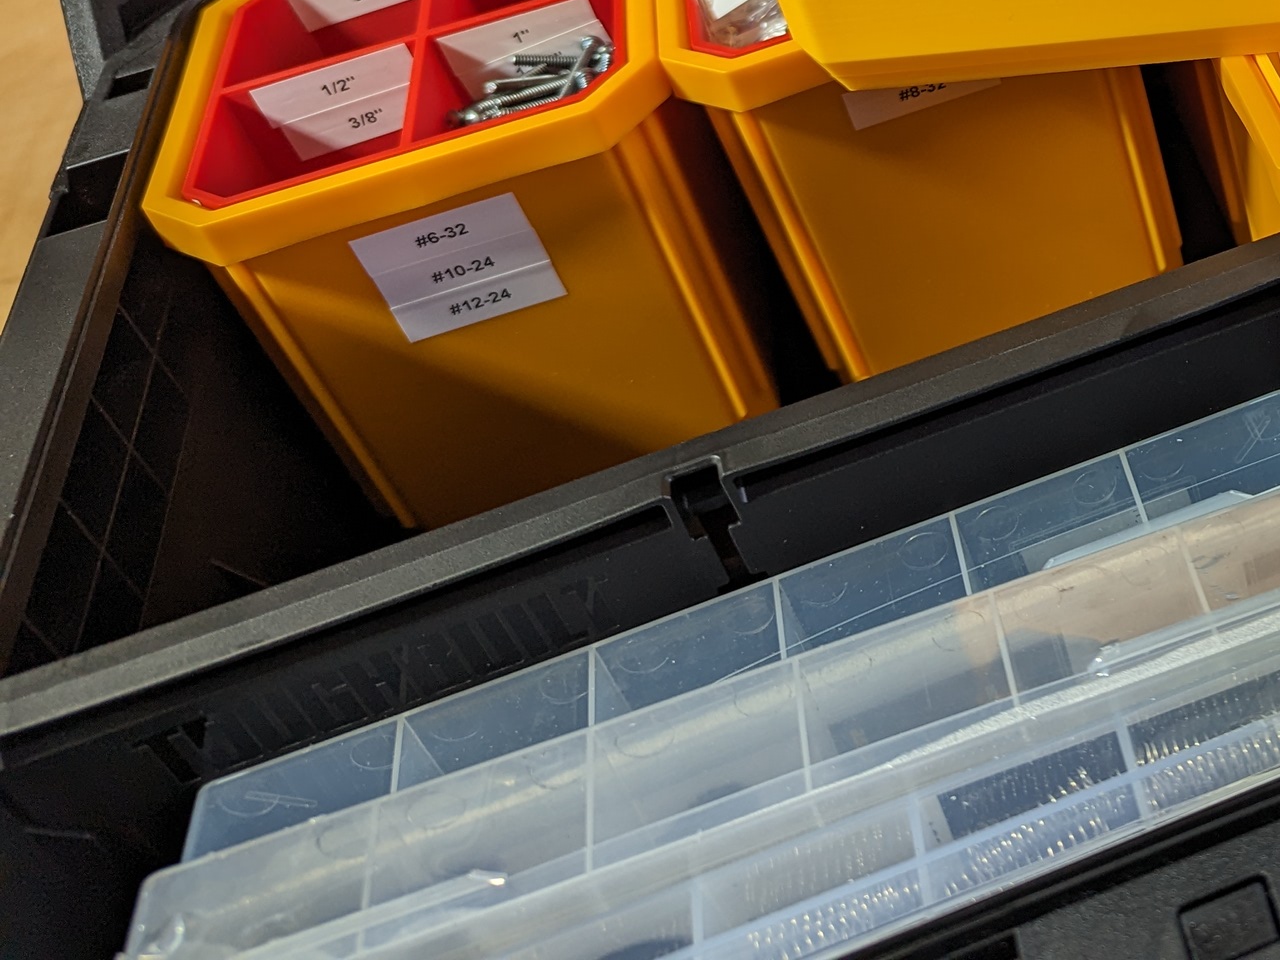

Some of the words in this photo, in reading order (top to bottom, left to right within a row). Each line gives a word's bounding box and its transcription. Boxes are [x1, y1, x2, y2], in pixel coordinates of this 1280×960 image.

[512, 28, 530, 44] 1"
[320, 75, 356, 97] 1/2"
[348, 107, 384, 130] 3/8"
[415, 223, 469, 248] #6-32
[432, 256, 495, 283] #10-24
[450, 288, 512, 315] #12-24
